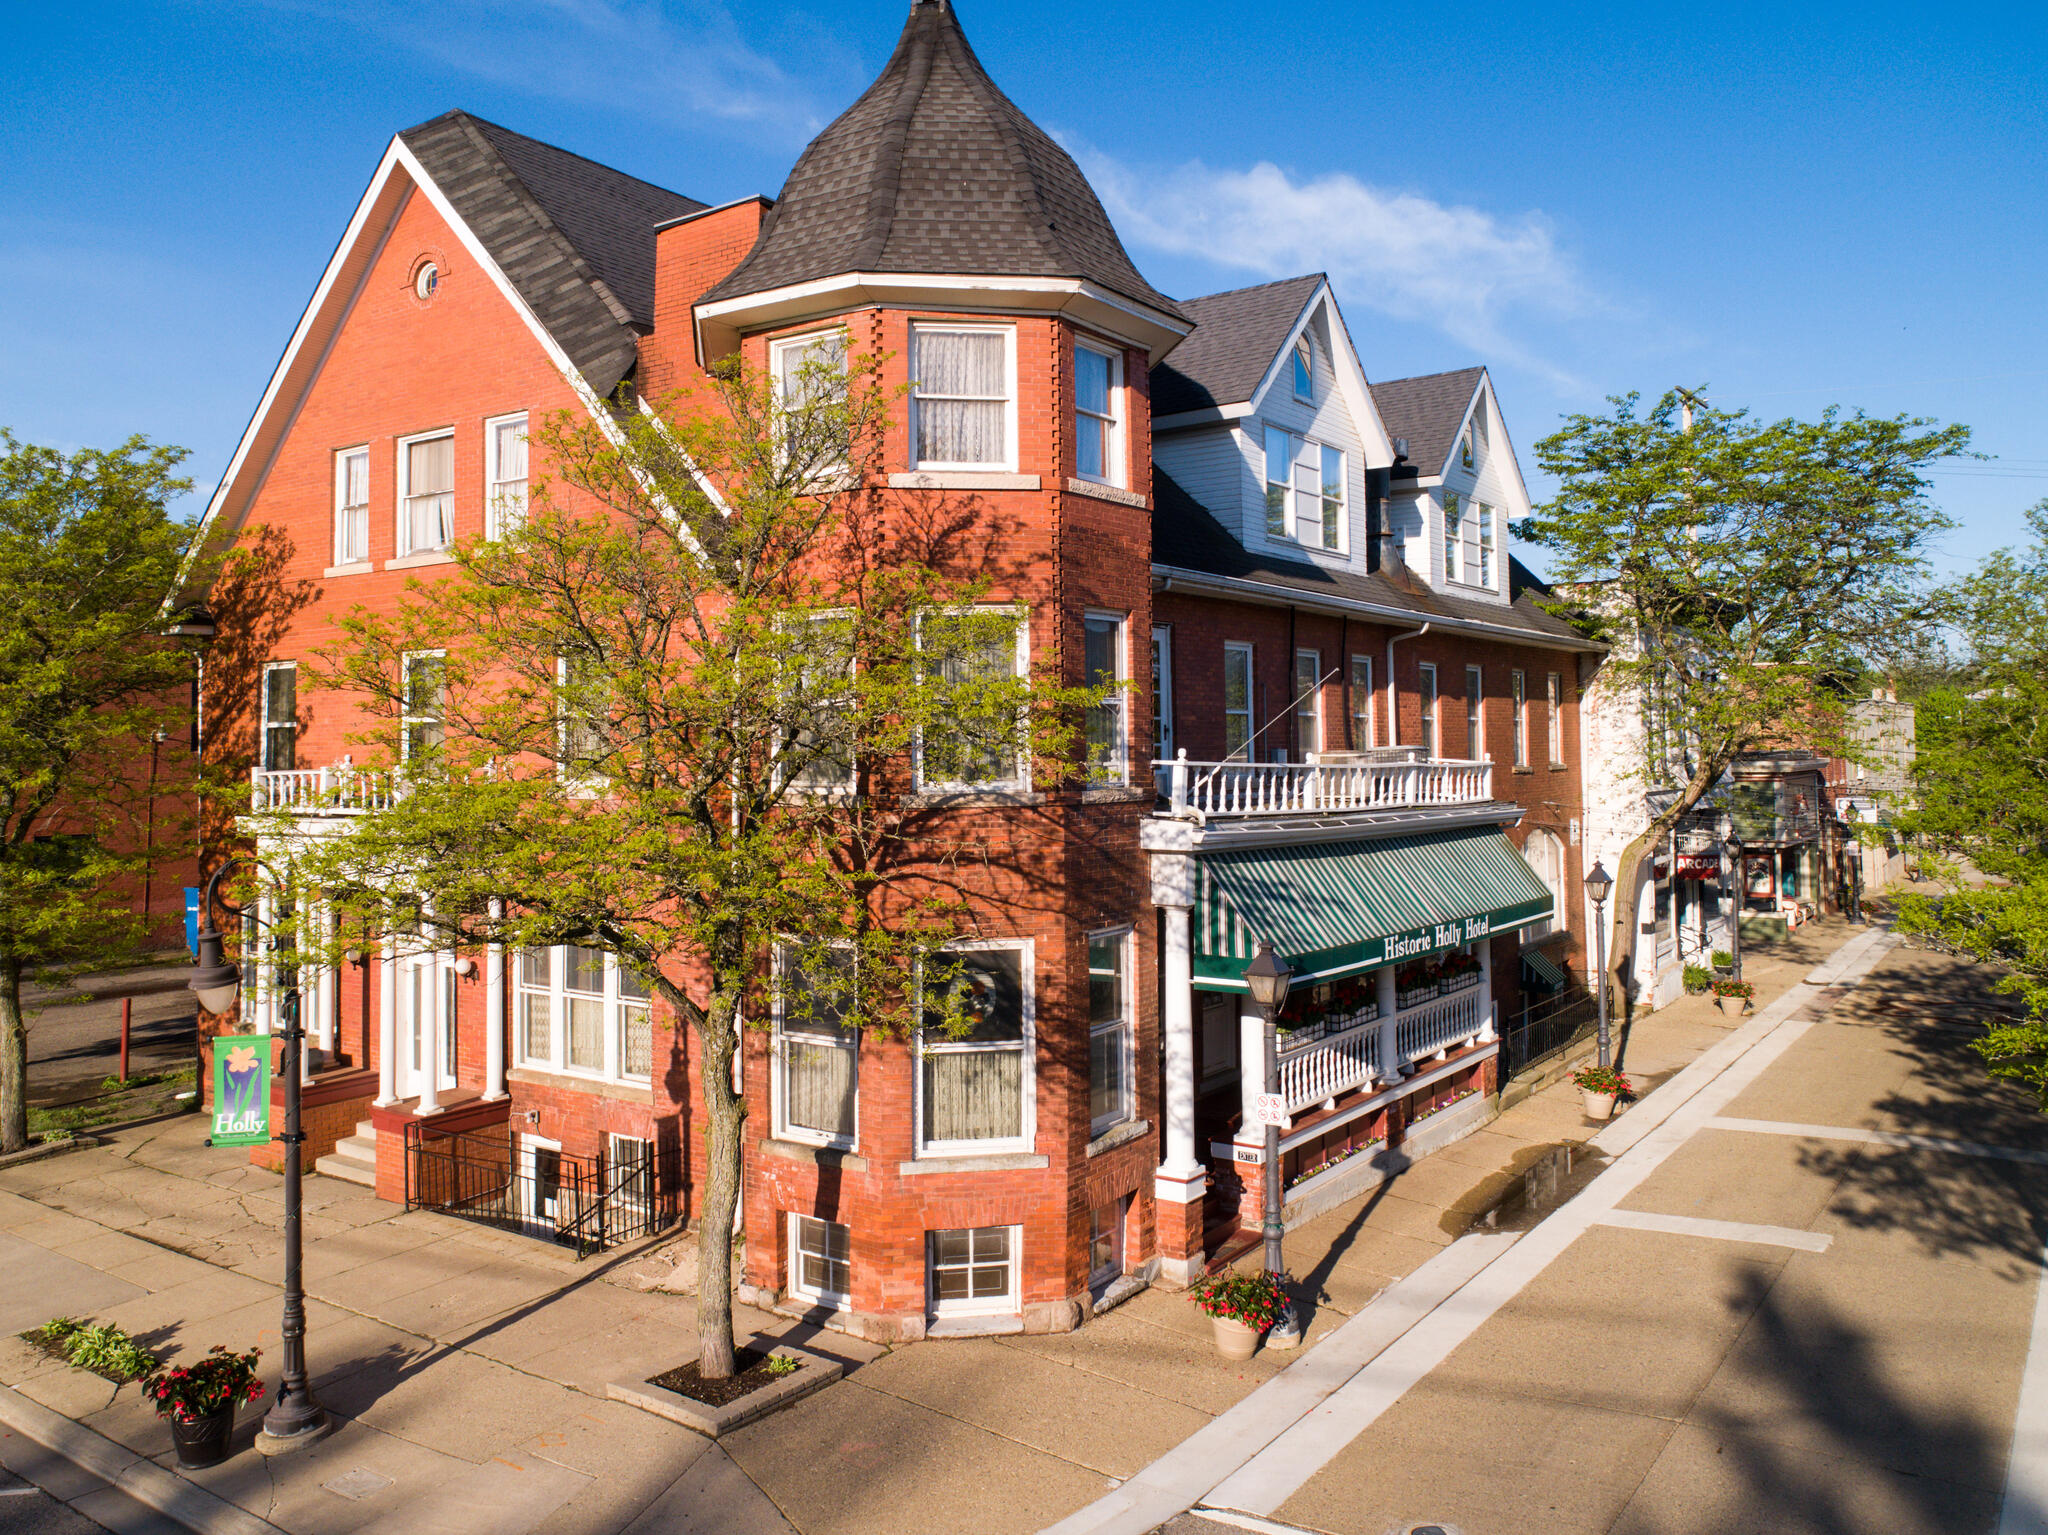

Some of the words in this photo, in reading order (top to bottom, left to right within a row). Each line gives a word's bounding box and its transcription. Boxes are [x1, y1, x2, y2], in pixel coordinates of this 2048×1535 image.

[1677, 858, 1719, 869] ARCADE
[1384, 928, 1431, 960] Historic
[1434, 923, 1462, 947] Holly
[1465, 915, 1489, 940] Hotel
[215, 1111, 266, 1134] Holly
